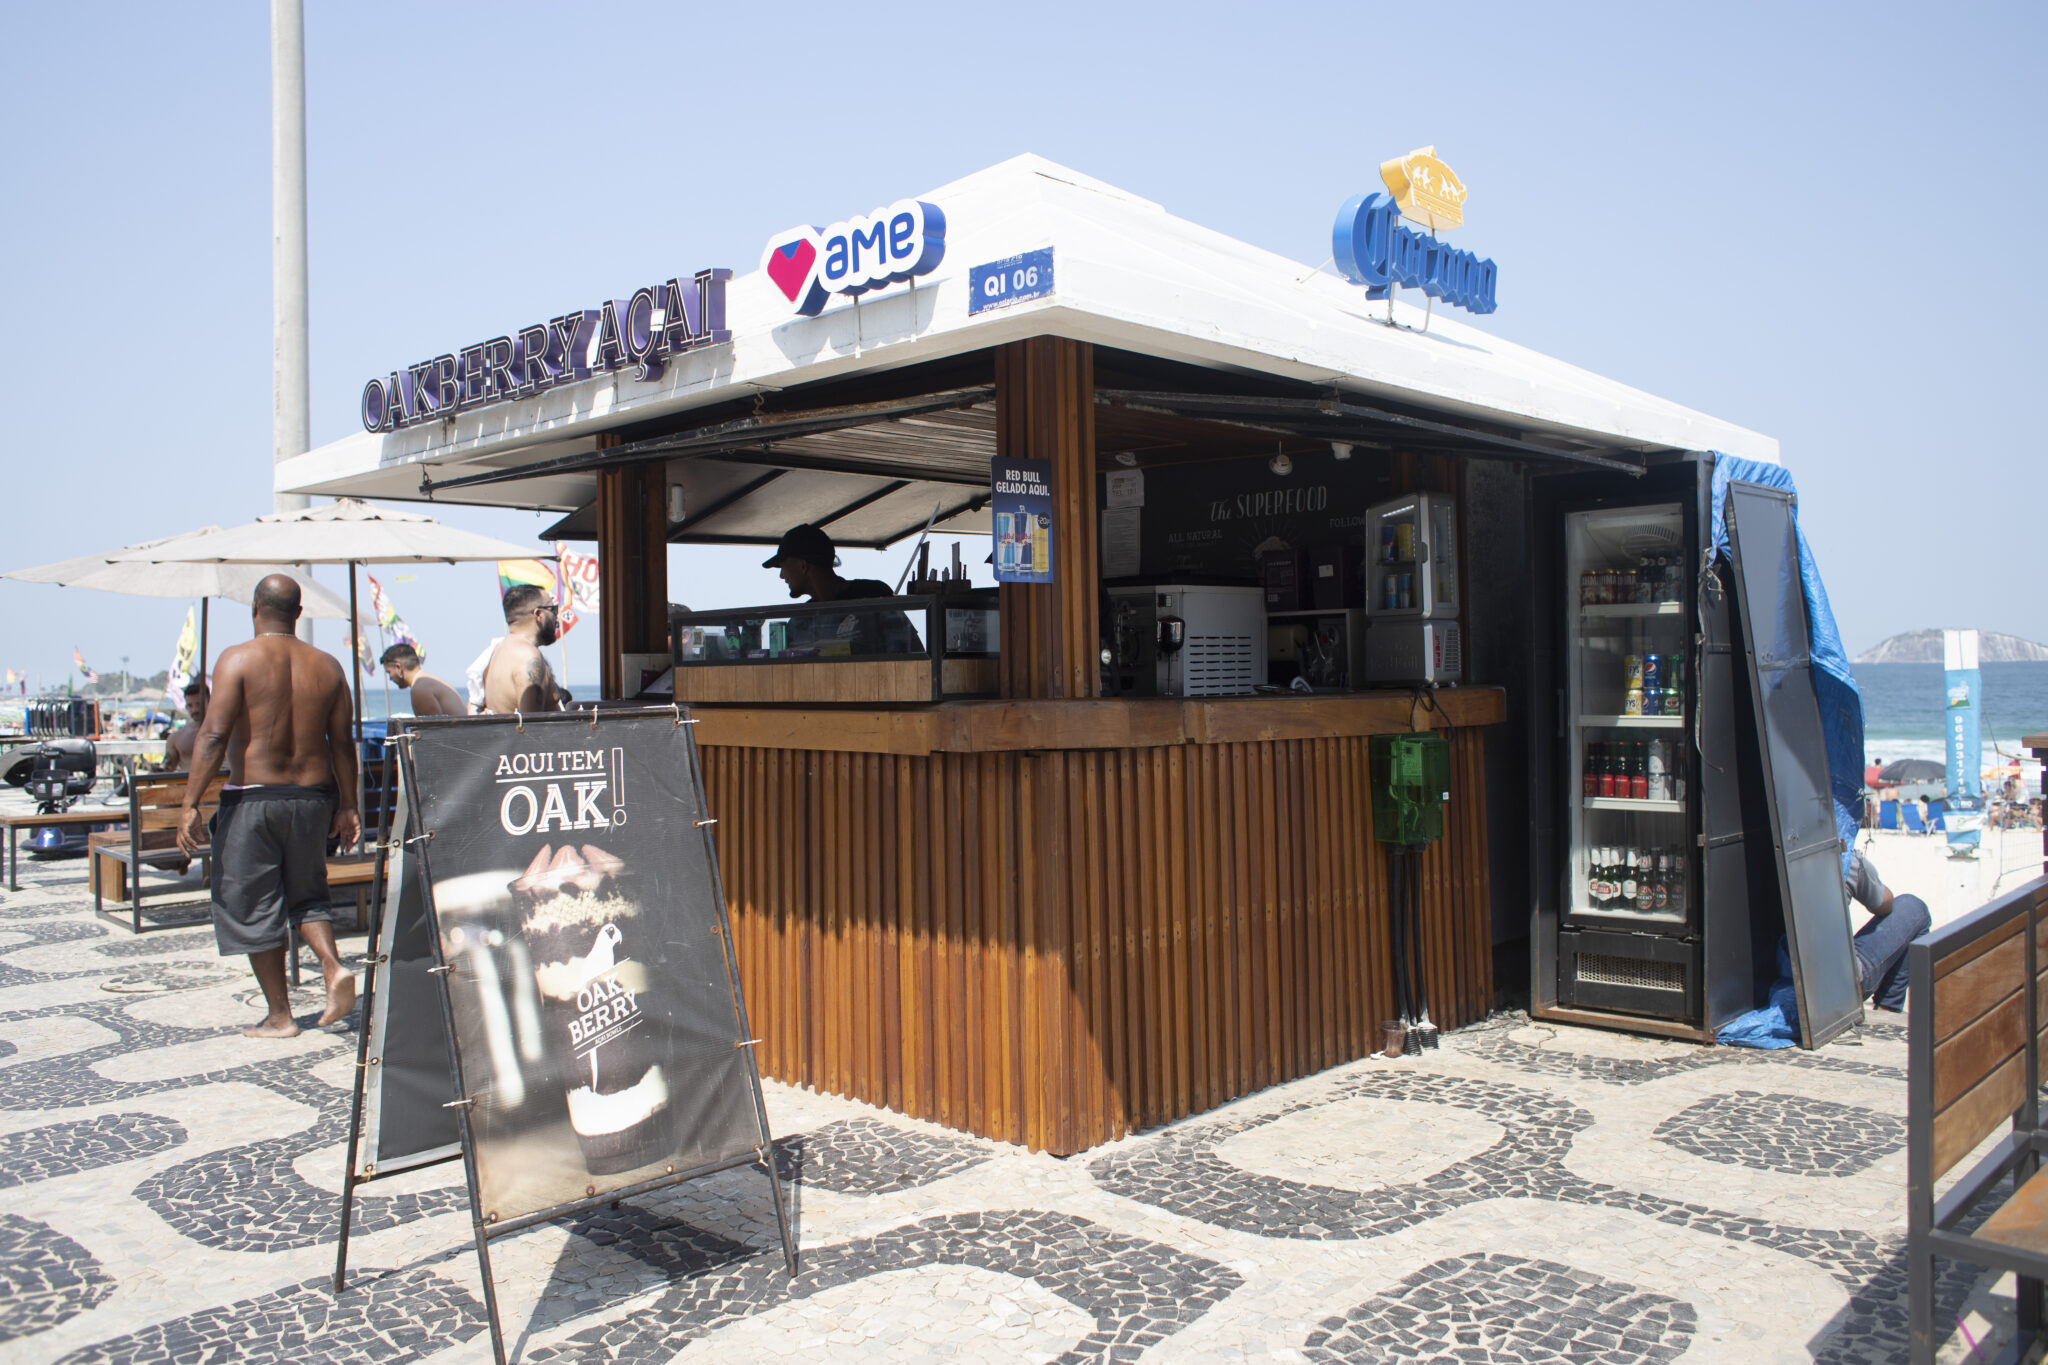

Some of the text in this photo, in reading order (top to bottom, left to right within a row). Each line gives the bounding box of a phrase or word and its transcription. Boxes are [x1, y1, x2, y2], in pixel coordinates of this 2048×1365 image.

[1335, 191, 1498, 314] Corona
[984, 266, 1038, 297] QI 06
[361, 267, 727, 434] OAKBERRY AÇAI
[995, 482, 1050, 496] GELADO AQUI.
[1005, 469, 1041, 483] RED BULL
[1210, 485, 1327, 522] The SUPERFOOD
[1167, 529, 1224, 544] ALL NATURAL
[495, 749, 605, 776] AQUI TEM
[576, 972, 624, 1013] OAK
[567, 988, 638, 1046] BERRY
